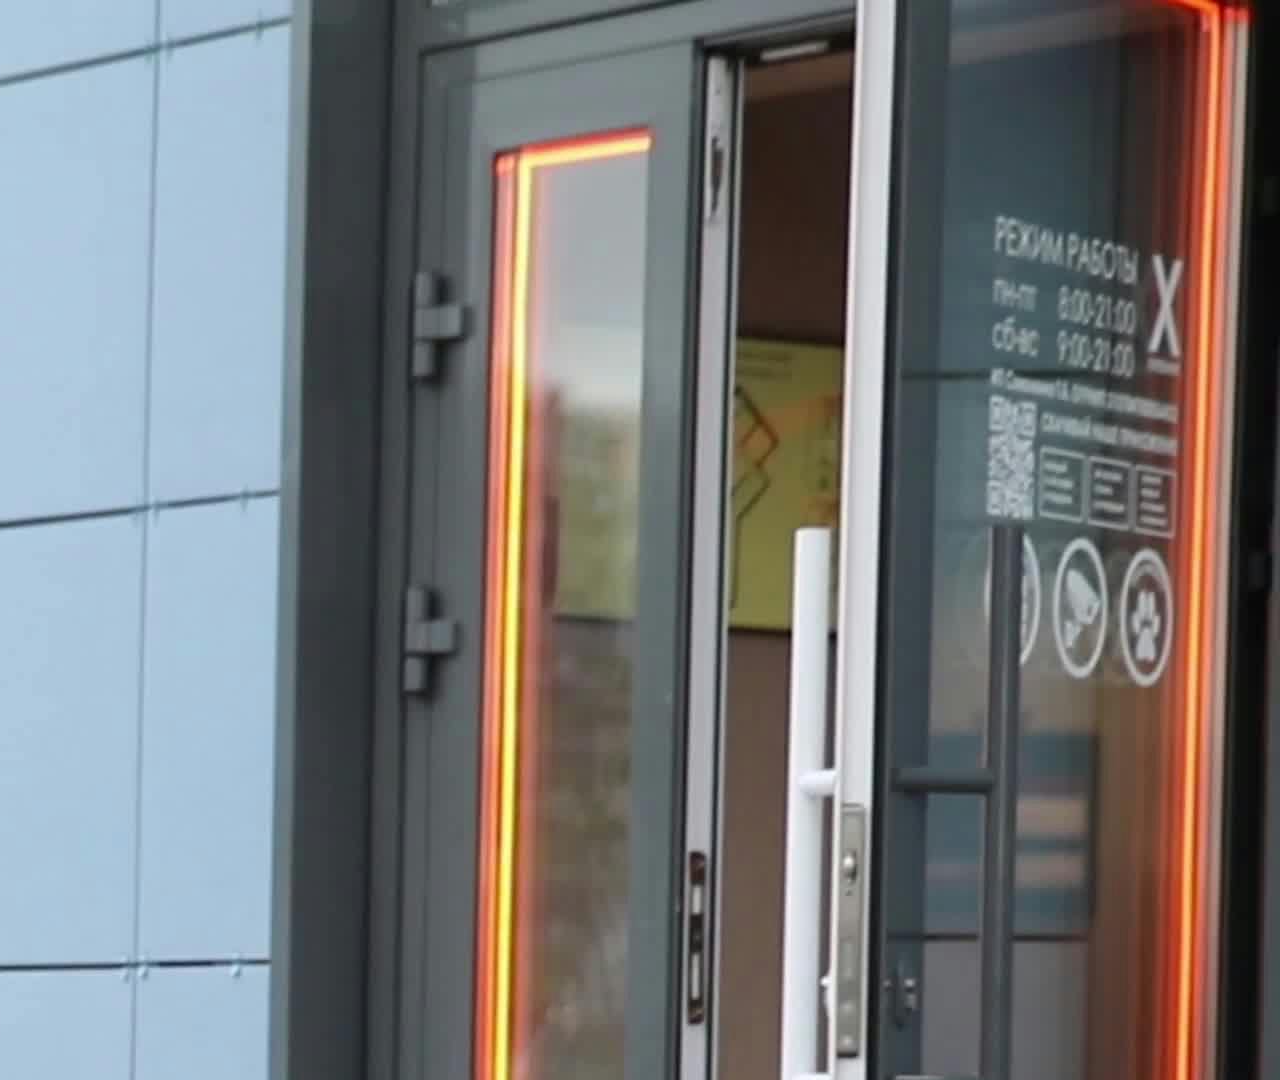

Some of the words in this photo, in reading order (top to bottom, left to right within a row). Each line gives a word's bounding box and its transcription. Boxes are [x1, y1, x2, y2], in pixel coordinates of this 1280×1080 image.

[993, 215, 1064, 266] РЕЖИМ
[1065, 232, 1139, 285] РАБОТЫ
[1058, 285, 1136, 335] 8:00-21:00
[1057, 330, 1136, 378] 9:00-21:00
